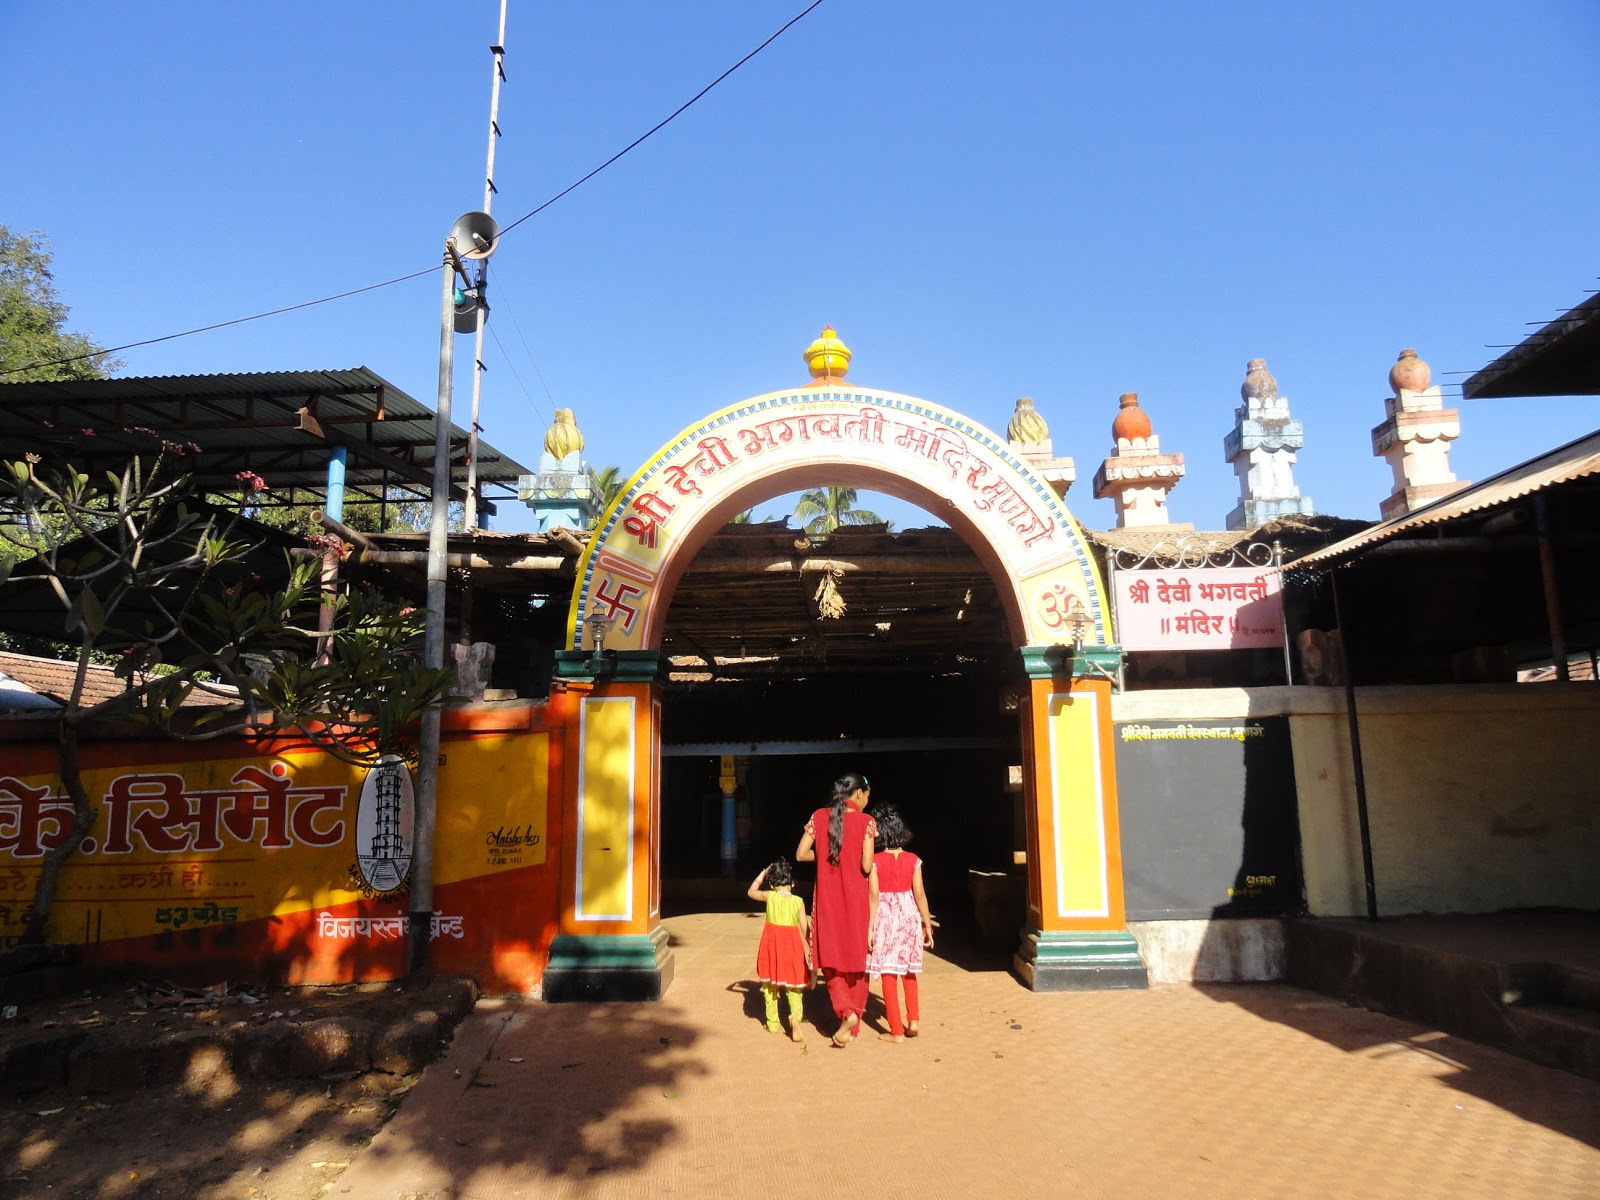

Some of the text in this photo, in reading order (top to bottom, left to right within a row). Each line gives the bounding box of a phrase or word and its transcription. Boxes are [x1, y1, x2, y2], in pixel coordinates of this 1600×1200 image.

[623, 407, 1055, 549] श्री देवी भगवती मंदिर मुणगे
[1128, 577, 1268, 604] श्री देवी भगवती
[1175, 609, 1225, 635] मंदिर
[1151, 724, 1187, 740] भगवती
